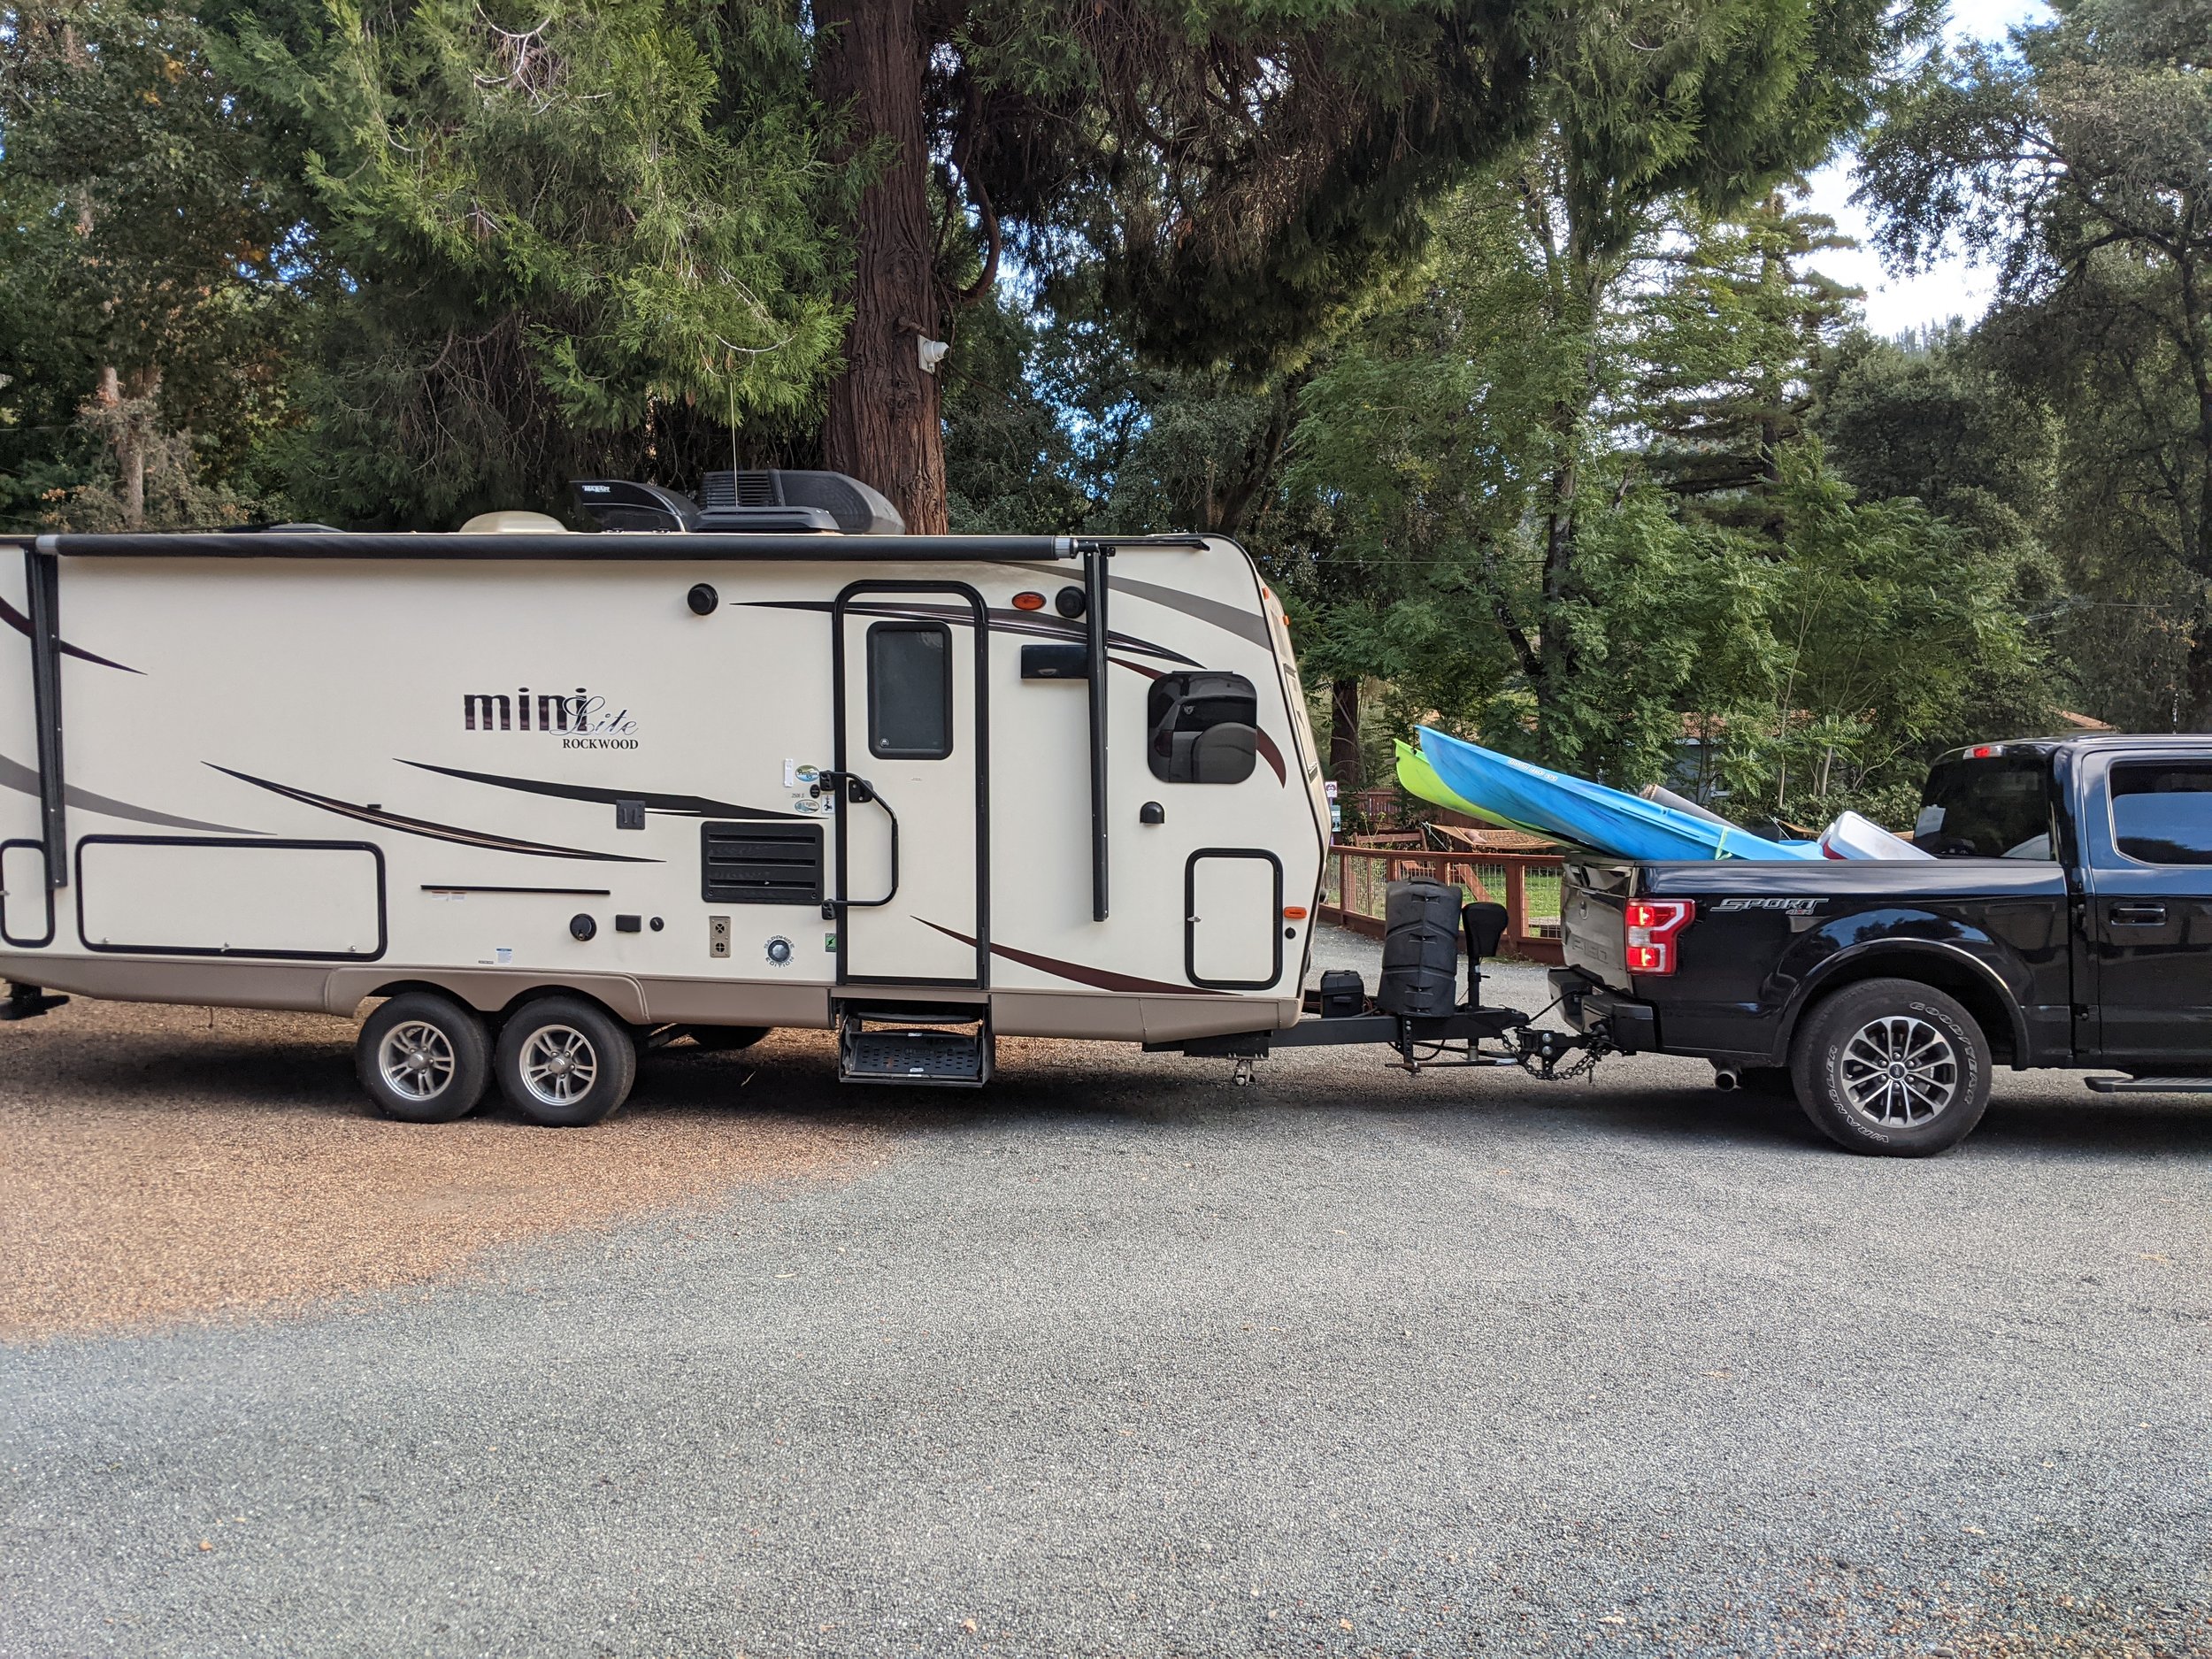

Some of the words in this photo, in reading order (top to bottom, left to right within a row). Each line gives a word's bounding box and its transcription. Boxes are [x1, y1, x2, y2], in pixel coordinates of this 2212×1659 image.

[464, 687, 588, 731] mini
[549, 695, 639, 735] Lite
[562, 738, 639, 750] ROCKWOOD
[1709, 897, 1830, 912] SPORT
[765, 956, 795, 968] EDITION
[1909, 1002, 1978, 1104] GOODYEAR
[1825, 1045, 1889, 1143] WRANGLER
